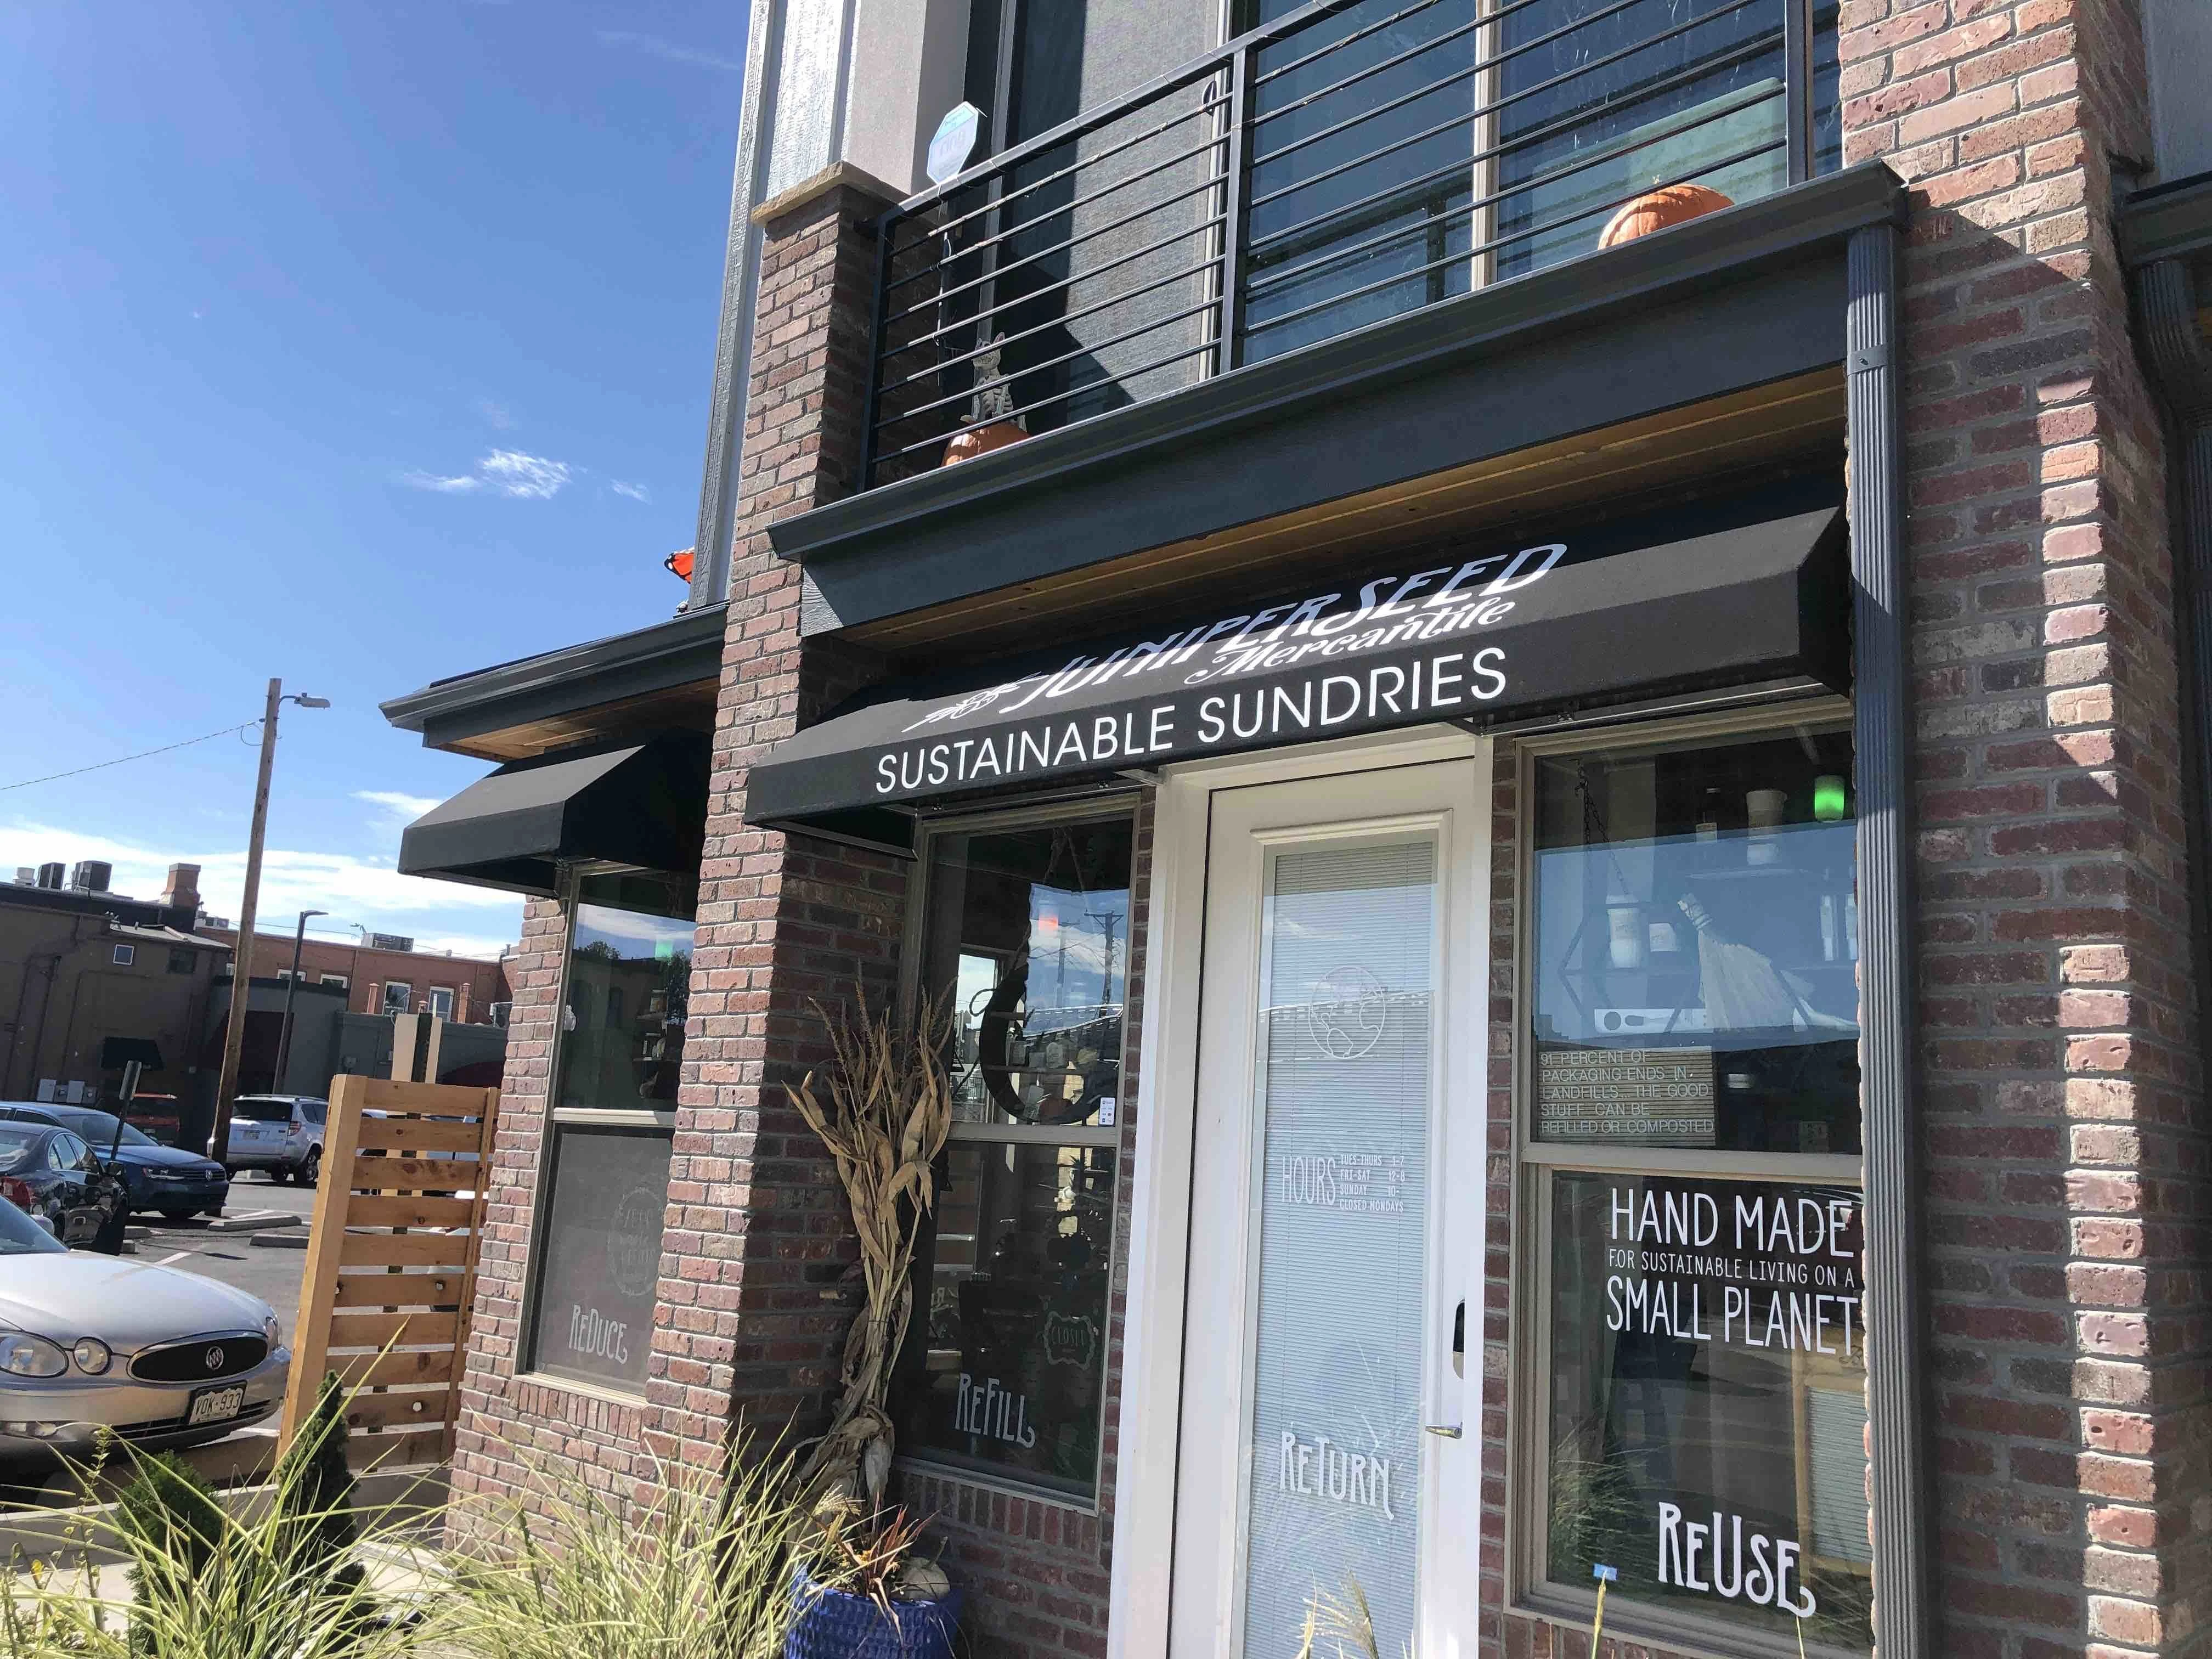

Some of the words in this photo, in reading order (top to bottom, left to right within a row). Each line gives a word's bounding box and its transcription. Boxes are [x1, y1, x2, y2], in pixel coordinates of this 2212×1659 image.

[1184, 597, 1515, 685] Mercantile
[876, 705, 1175, 793] SUSTAINABLE
[1198, 647, 1506, 743] SUNDRIES
[1542, 1068, 1621, 1082] PACKAGING
[1627, 1066, 1664, 1080] ENDS
[1561, 1051, 1624, 1065] PERCENT
[1632, 1050, 1651, 1063] OF
[1541, 1103, 1584, 1116] STUFF
[1595, 1103, 1625, 1116] CAN
[1631, 1102, 1650, 1115] BE
[1634, 1084, 1661, 1098] THE
[1667, 1083, 1708, 1097] GOOD
[1542, 1120, 1598, 1133] REFILLED
[1601, 1120, 1620, 1133] OR
[1627, 1119, 1714, 1133] COMPOSTED
[1282, 1156, 1336, 1205] HOURS
[1339, 1184, 1368, 1195] SUNDAY
[1339, 1199, 1367, 1211] CLOSED
[1612, 1188, 1718, 1246] HAND
[1736, 1195, 1854, 1258] MADE
[1609, 1249, 1635, 1270] FOR
[1641, 1251, 1742, 1279] SUSTAINABLE
[1750, 1260, 1808, 1284] LIVING
[1815, 1265, 1836, 1286] ON
[1845, 1267, 1855, 1288] A
[1607, 1276, 1712, 1341] SMALL
[1725, 1286, 1859, 1356] PLANET
[1280, 1431, 1395, 1521] RETURN
[1658, 1502, 1816, 1618] REUSE
